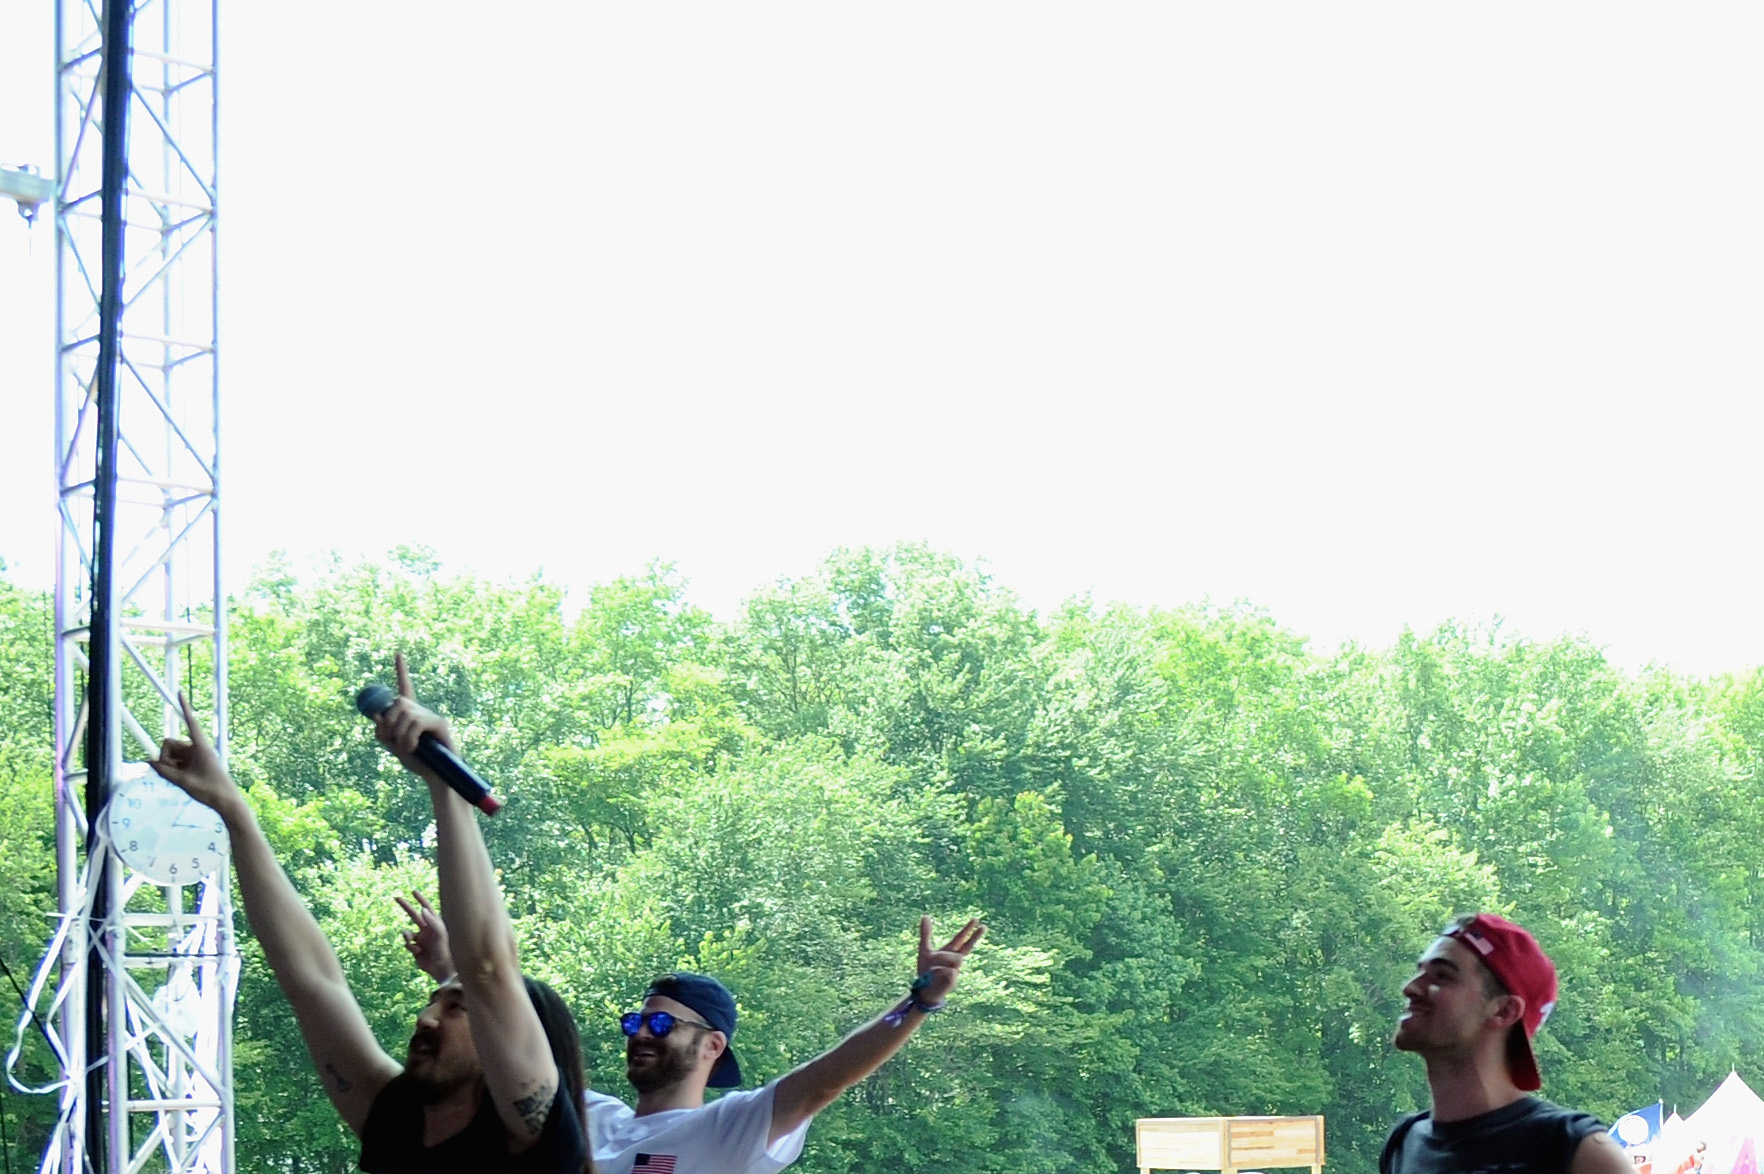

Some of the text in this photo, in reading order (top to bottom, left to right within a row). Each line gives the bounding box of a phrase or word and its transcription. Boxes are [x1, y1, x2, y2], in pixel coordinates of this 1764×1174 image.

[122, 818, 131, 828] 9
[215, 823, 223, 833] 3
[129, 841, 139, 852] 8
[207, 842, 216, 852] 4
[169, 863, 178, 874] 6
[192, 858, 199, 869] 5
